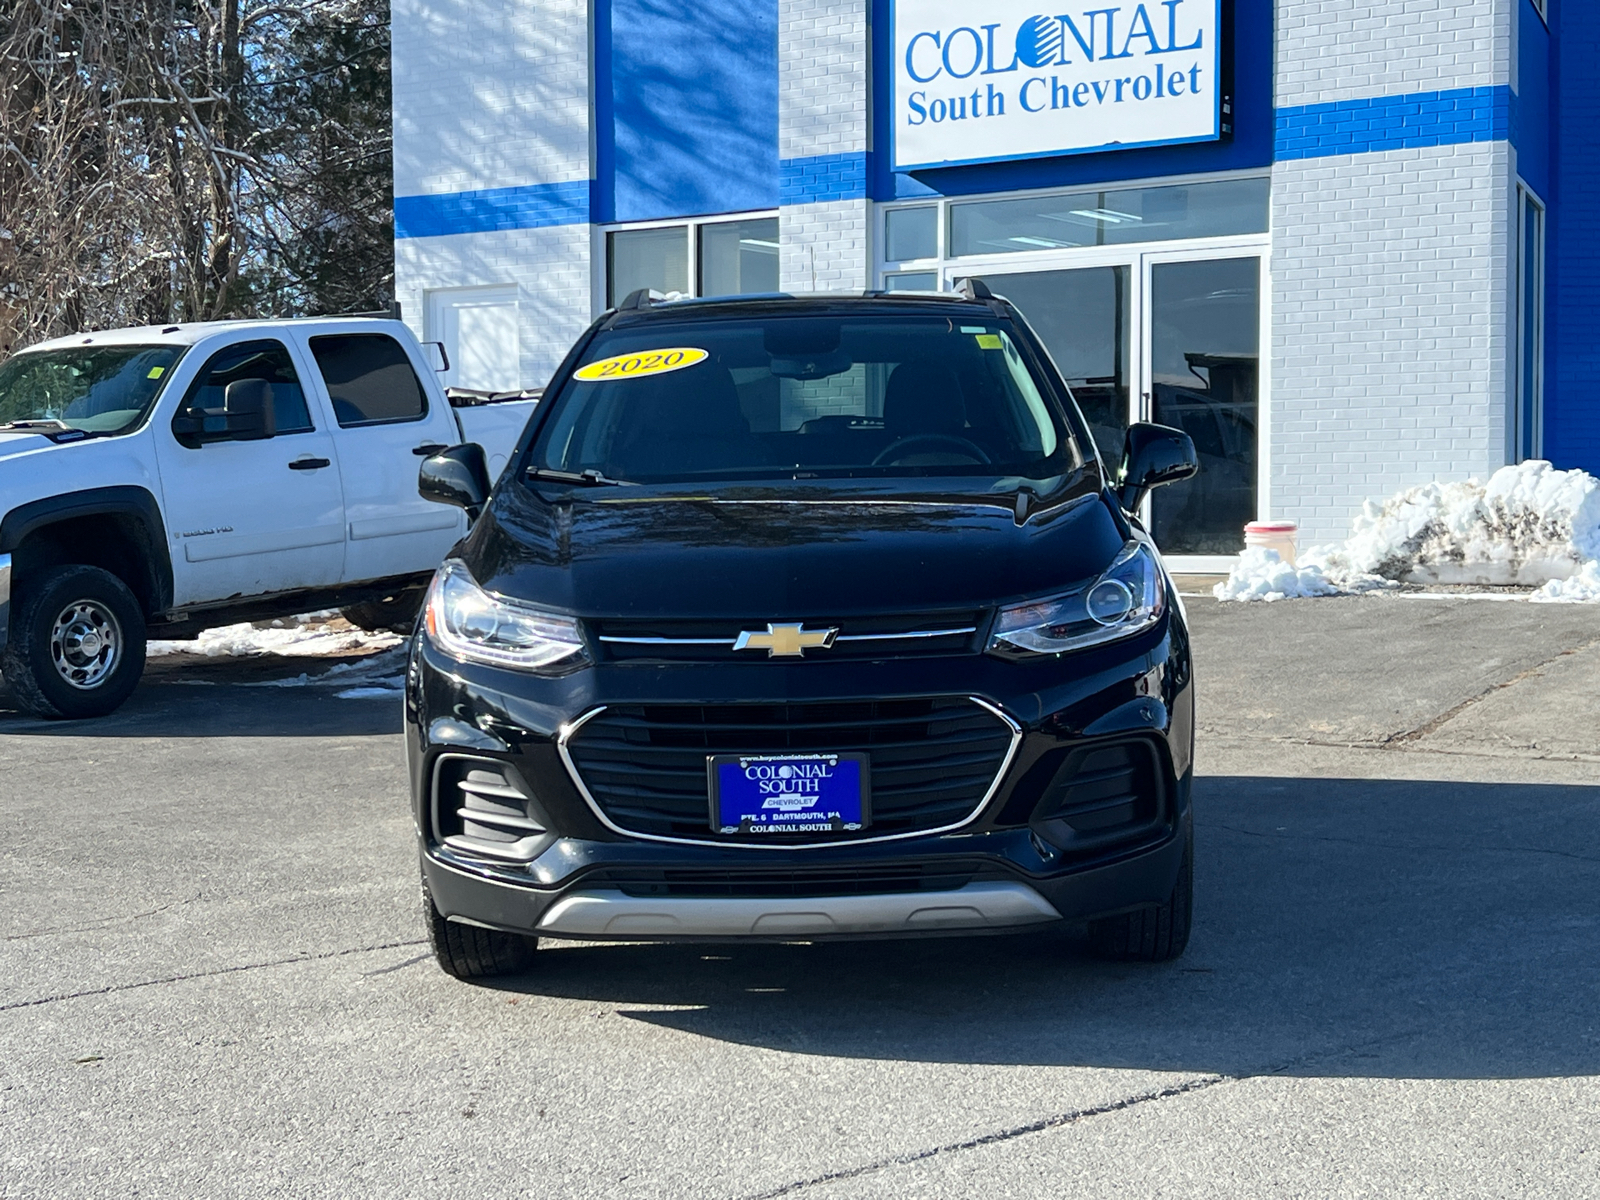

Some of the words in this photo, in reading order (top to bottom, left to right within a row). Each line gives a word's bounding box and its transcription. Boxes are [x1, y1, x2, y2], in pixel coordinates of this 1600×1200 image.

[905, 0, 1203, 83] COLONIAL
[907, 84, 1006, 126] South
[1019, 62, 1203, 113] Chevrolet
[598, 352, 685, 377] 2020
[745, 764, 833, 780] COLONIAL
[759, 779, 820, 794] SOUTH
[767, 798, 814, 806] CHEVROLET
[772, 812, 827, 820] DARTMOUTH,
[750, 824, 799, 833] COLONIAL
[799, 823, 832, 832] SOUTH
